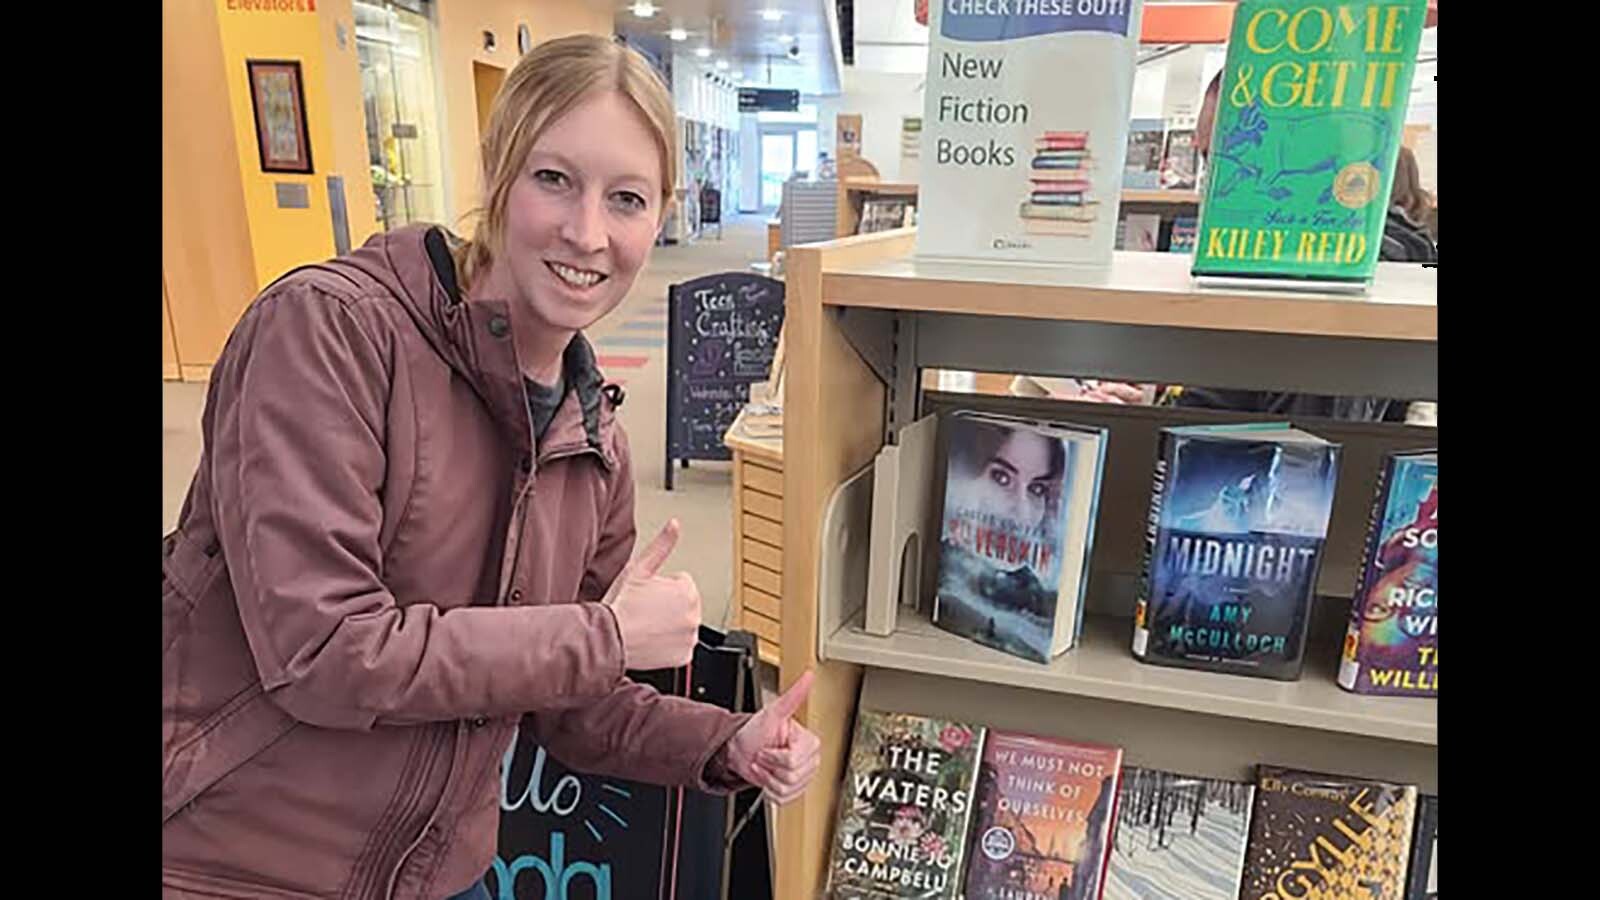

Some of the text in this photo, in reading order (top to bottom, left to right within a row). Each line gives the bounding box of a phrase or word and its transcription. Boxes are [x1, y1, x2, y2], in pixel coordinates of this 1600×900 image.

[948, 0, 1125, 15] CHECK THESE OUT!
[1246, 6, 1409, 54] COME
[942, 52, 1004, 79] New
[1231, 60, 1405, 108] & GET IT
[939, 95, 1029, 124] Fiction
[937, 138, 1015, 166] Books
[1206, 227, 1366, 264] KILEY REID
[696, 311, 768, 346] Crafting
[1165, 536, 1315, 584] MIDNIGHT
[1209, 604, 1252, 623] AMY
[1170, 624, 1287, 654] McCULLOCH
[890, 746, 941, 775] THE
[995, 751, 1106, 778] WE MUST NOT
[854, 773, 967, 814] WATERS
[1007, 775, 1082, 799] THINK OF
[998, 797, 1085, 823] OURSELVES
[842, 833, 953, 869] BONNIE JO
[844, 857, 948, 892] CAMPBELL
